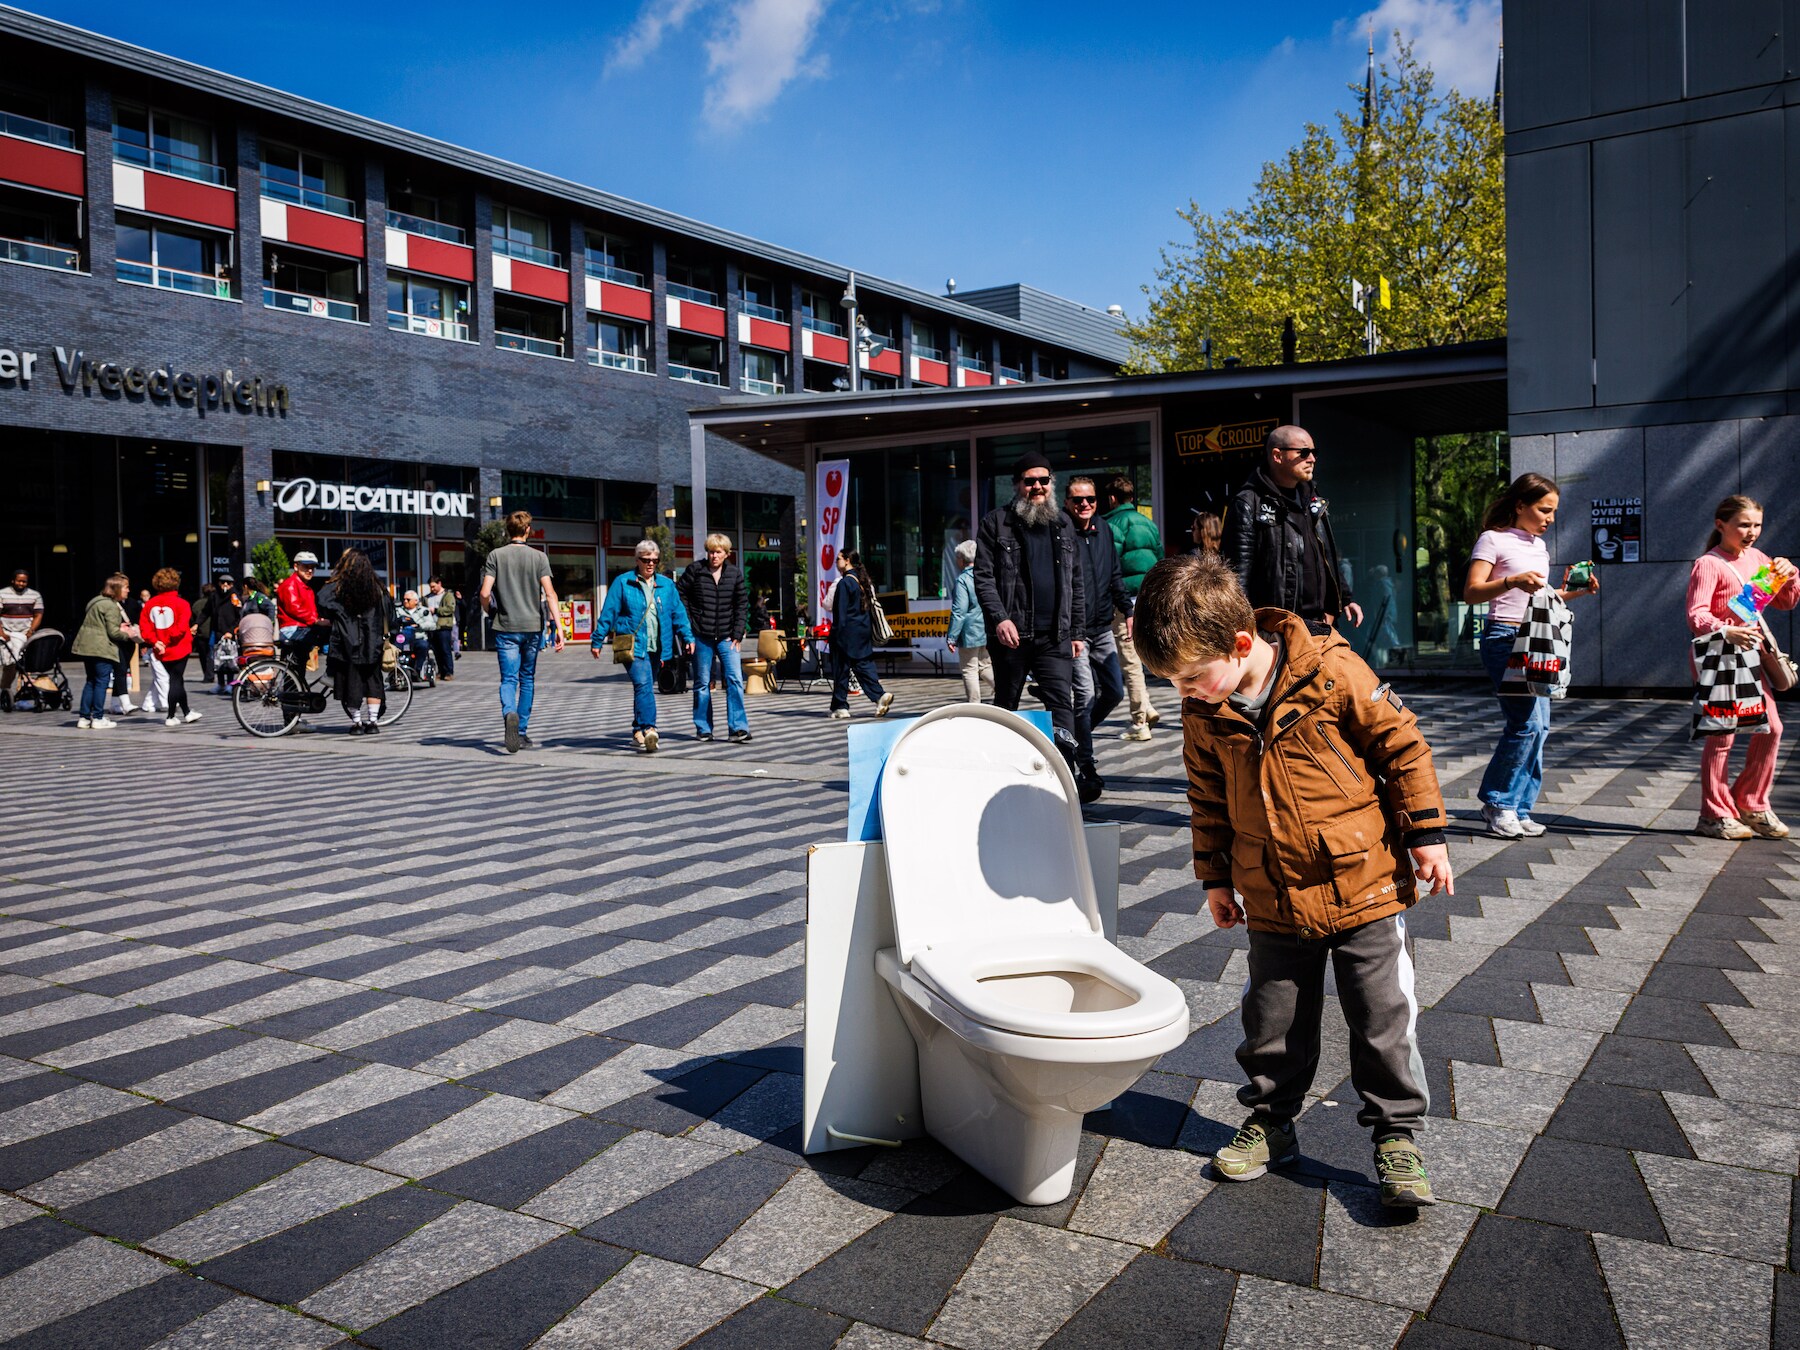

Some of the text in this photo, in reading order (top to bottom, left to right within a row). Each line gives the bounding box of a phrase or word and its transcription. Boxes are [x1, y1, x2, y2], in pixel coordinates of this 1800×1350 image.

[53, 346, 289, 410] Vreedeplein
[1181, 434, 1204, 452] TOP
[320, 483, 468, 518] DECATHLON
[1591, 498, 1641, 507] TILBURG
[1591, 507, 1641, 516] OVER DE
[822, 507, 840, 535] SP
[1591, 517, 1622, 525] ZEIK!
[886, 616, 949, 628] erlijke KOFFIE
[918, 629, 947, 638] lekker
